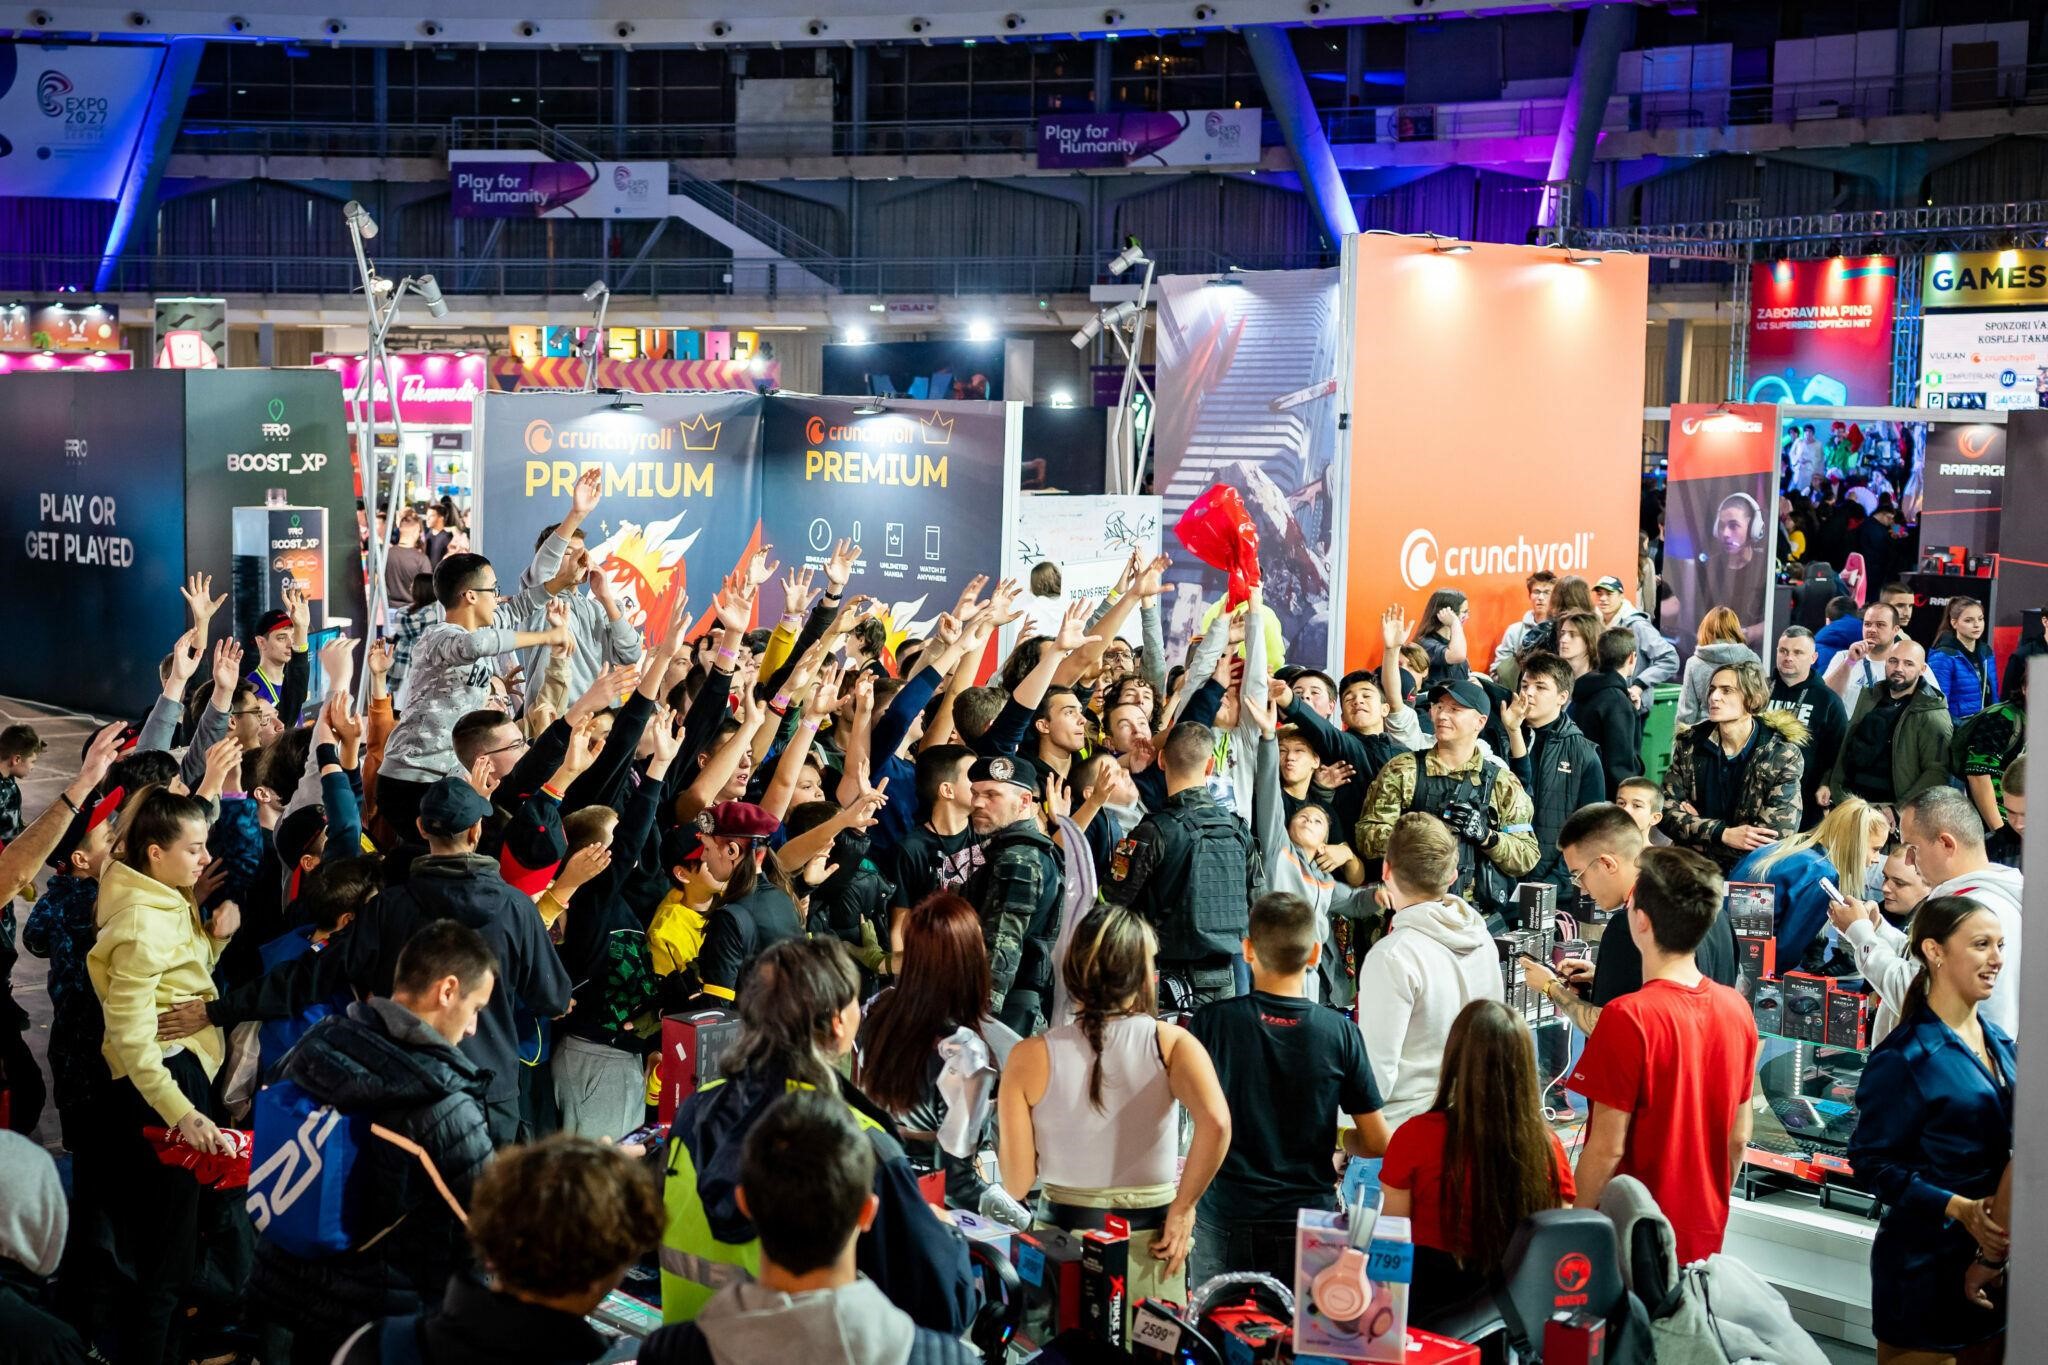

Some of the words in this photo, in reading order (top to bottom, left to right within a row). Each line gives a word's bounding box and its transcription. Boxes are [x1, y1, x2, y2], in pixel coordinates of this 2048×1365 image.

[65, 97, 108, 111] EXPO
[65, 111, 107, 124] 2027
[1045, 125, 1080, 142] Play
[1086, 125, 1109, 138] for
[1060, 138, 1138, 154] Humanity
[458, 174, 494, 190] Play
[498, 174, 521, 187] for
[473, 189, 549, 205] Humanity
[1933, 265, 2047, 291] GAMES
[1757, 307, 1819, 319] ZABORAVI
[1820, 306, 1839, 317] NA
[1841, 305, 1872, 316] PING
[1985, 321, 2031, 331] SPONZORI
[2034, 320, 2048, 330] VA
[1978, 335, 2019, 345] KOSPLEJ
[1930, 352, 1966, 361] VULKAN
[559, 427, 673, 455] crunchyroll
[227, 453, 328, 474] BOOST_XP
[805, 450, 948, 488] PREMIUM
[525, 460, 714, 498] PREMIUM
[40, 493, 85, 524] PLAY
[89, 495, 116, 526] OR
[25, 530, 59, 561] GET
[64, 533, 134, 568] PLAYED
[1444, 533, 1589, 576] crunchyroll
[880, 562, 909, 571] UNLIMITED
[919, 565, 939, 574] WATCH
[917, 574, 947, 583] ANYWHERE
[1070, 590, 1077, 599] 14
[1833, 1000, 1855, 1008] BACKLIT
[1142, 1320, 1170, 1342] 2599
